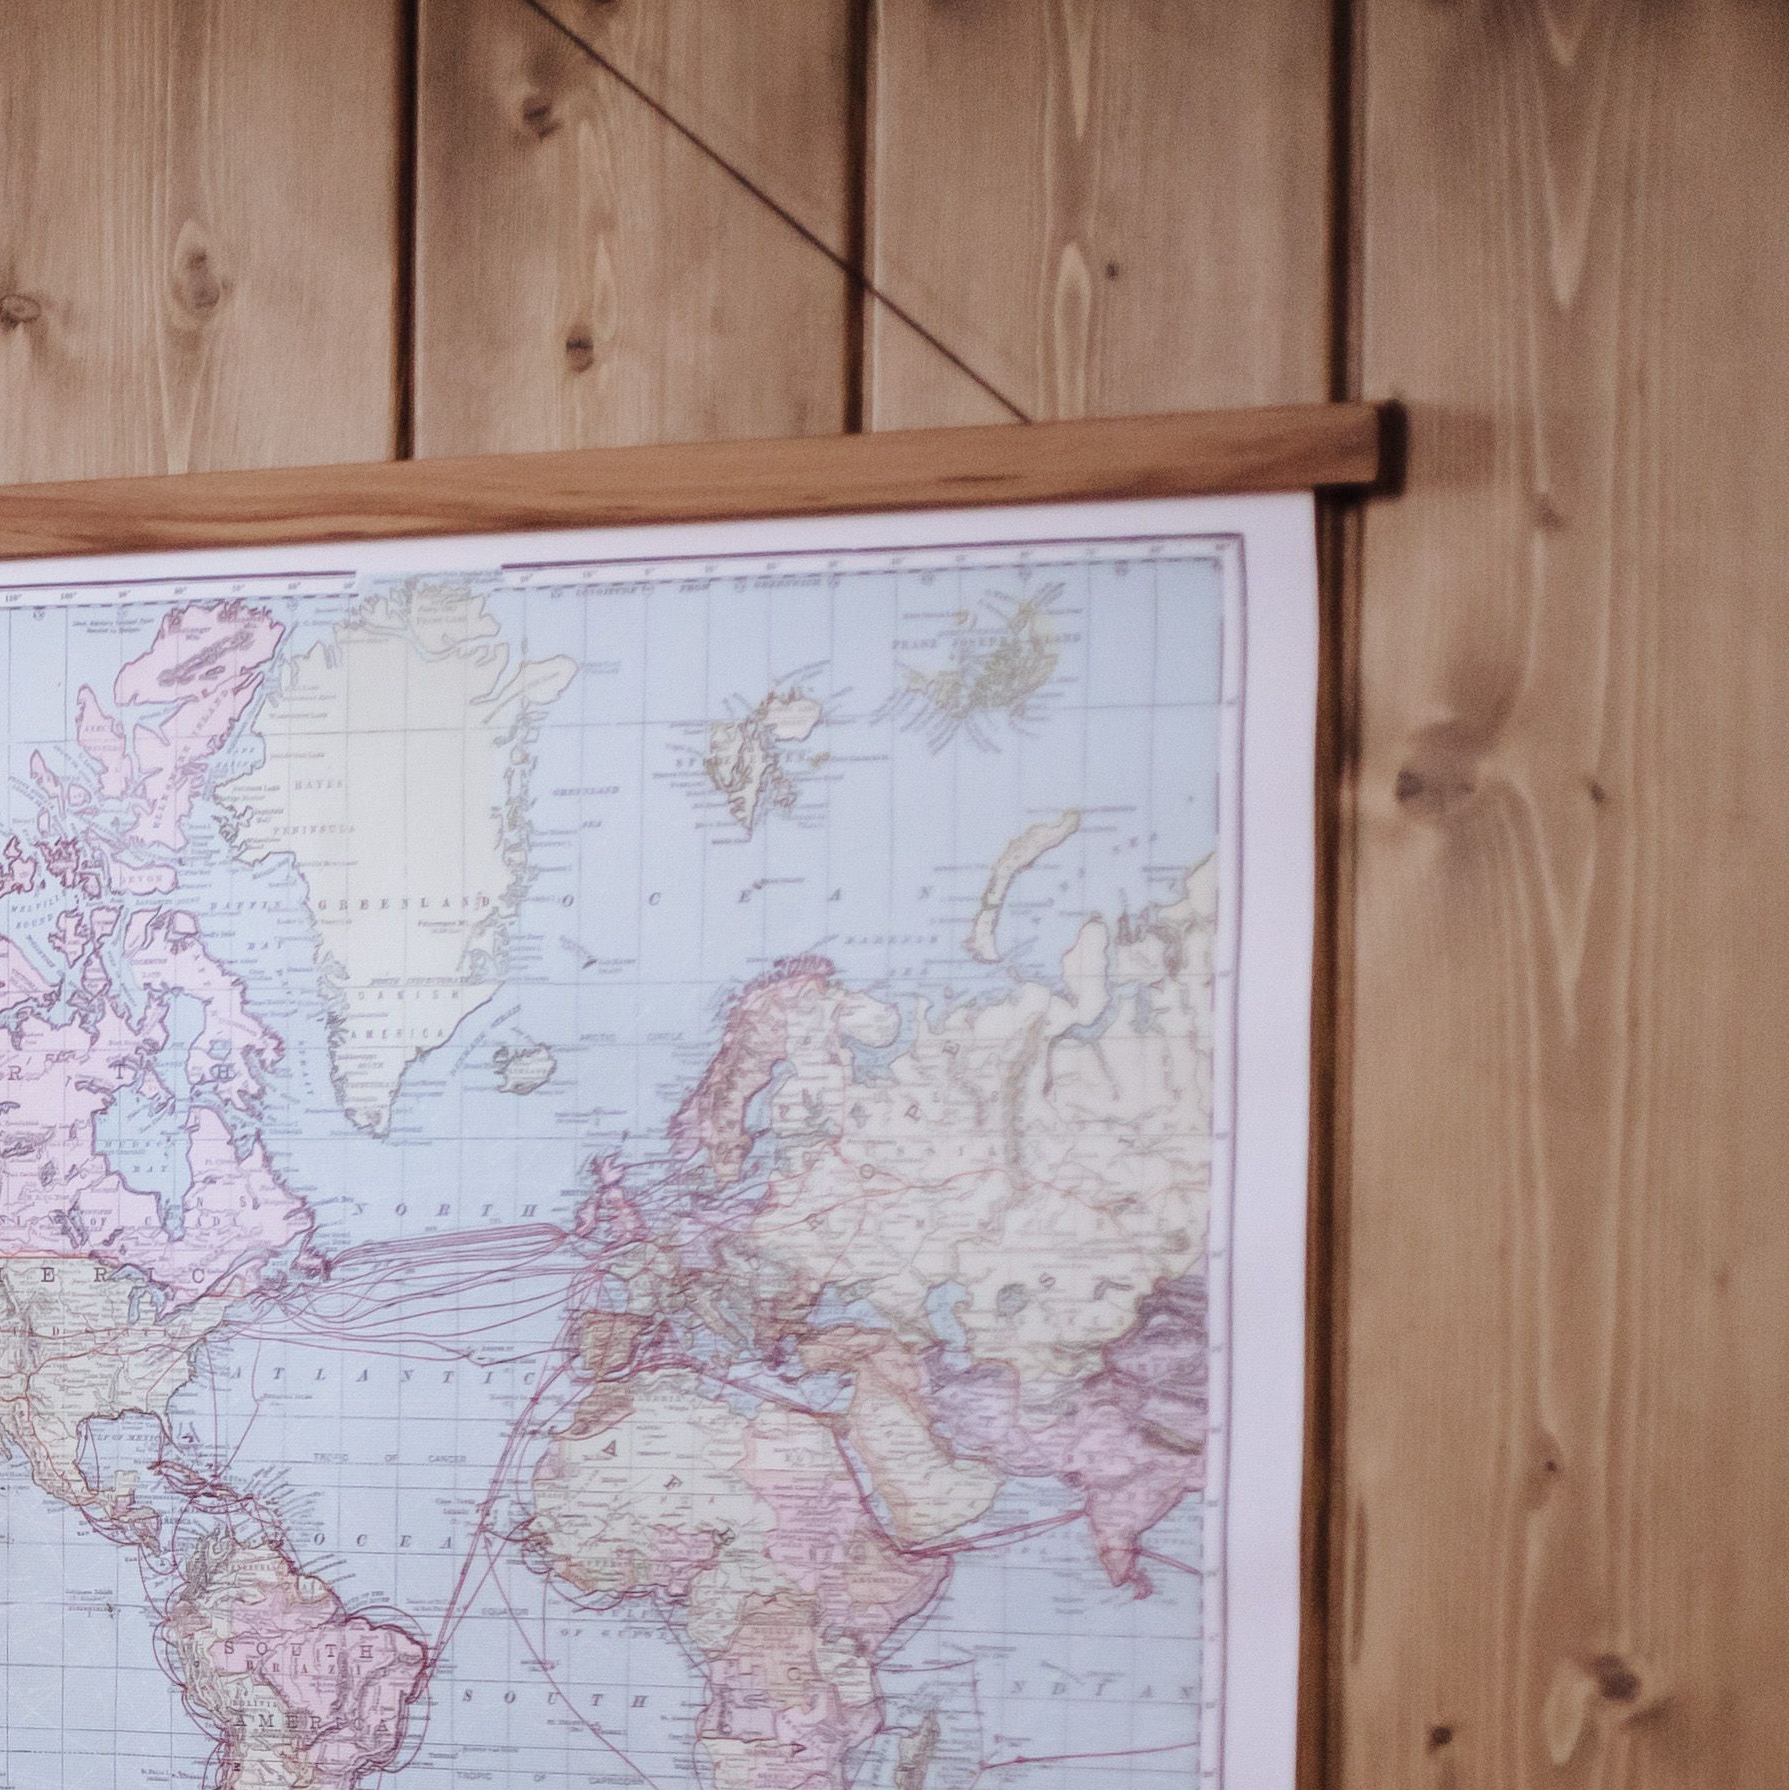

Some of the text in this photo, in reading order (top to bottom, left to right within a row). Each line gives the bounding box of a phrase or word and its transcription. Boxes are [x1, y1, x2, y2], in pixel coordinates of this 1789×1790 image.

[318, 896, 491, 911] GREENLAND
[482, 1606, 529, 1616] EQUATOR
[462, 1689, 650, 1708] SOUTH
